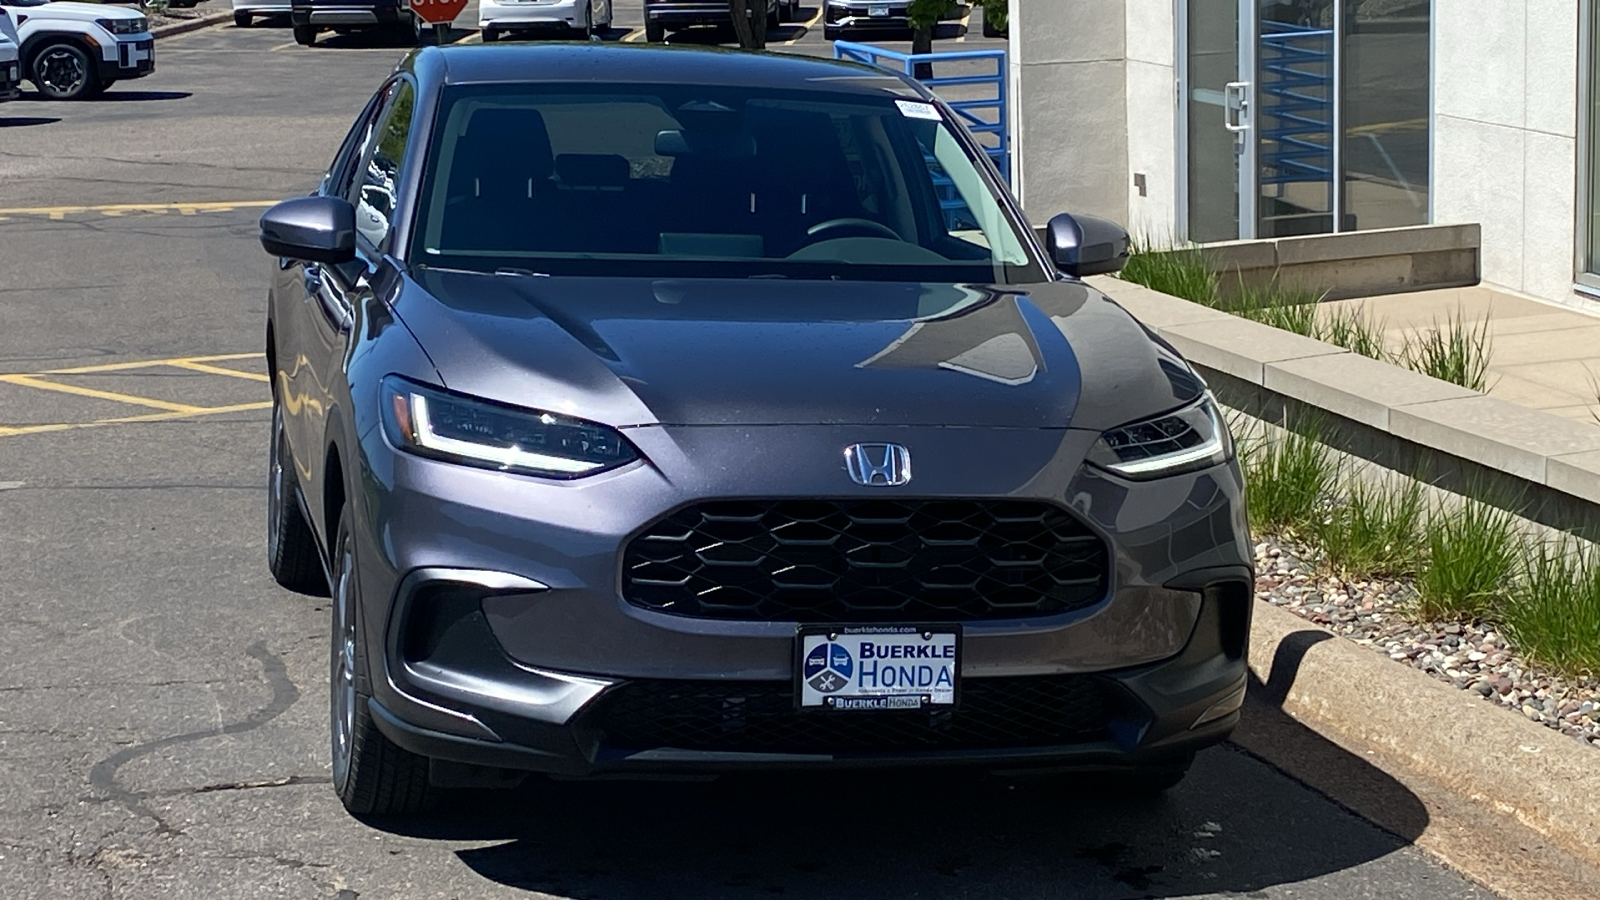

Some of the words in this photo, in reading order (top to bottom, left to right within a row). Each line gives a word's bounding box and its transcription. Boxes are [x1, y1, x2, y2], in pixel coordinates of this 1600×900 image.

[859, 642, 955, 659] BUERKLE
[858, 660, 953, 687] HONDA
[835, 697, 887, 709] BUERKLE
[888, 697, 919, 707] HONDA
